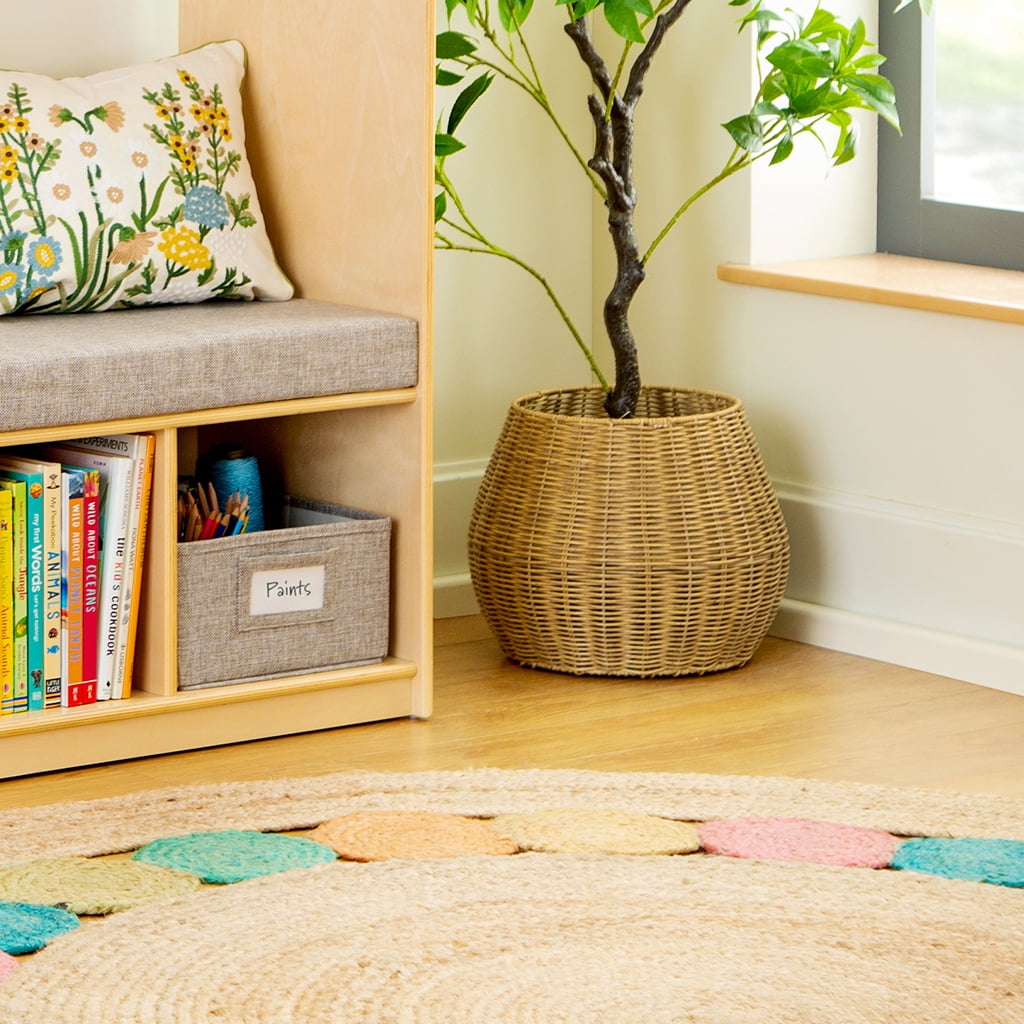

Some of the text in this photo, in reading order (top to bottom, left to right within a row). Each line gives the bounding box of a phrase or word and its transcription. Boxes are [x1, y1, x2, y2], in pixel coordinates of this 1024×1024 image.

[32, 513, 40, 526] my
[50, 497, 57, 508] My
[72, 504, 80, 528] WILD
[85, 501, 96, 613] WILD ABOUT OCEANS
[115, 537, 126, 557] the
[17, 568, 27, 601] Jungle
[30, 545, 44, 593] Words
[47, 551, 60, 620] ANIMALS
[71, 567, 80, 613] PLANET
[266, 580, 312, 598] Paints
[0, 605, 10, 641] Animal
[107, 596, 120, 656] cookbook
[70, 621, 80, 663] EARTH
[0, 643, 11, 678] Sounds
